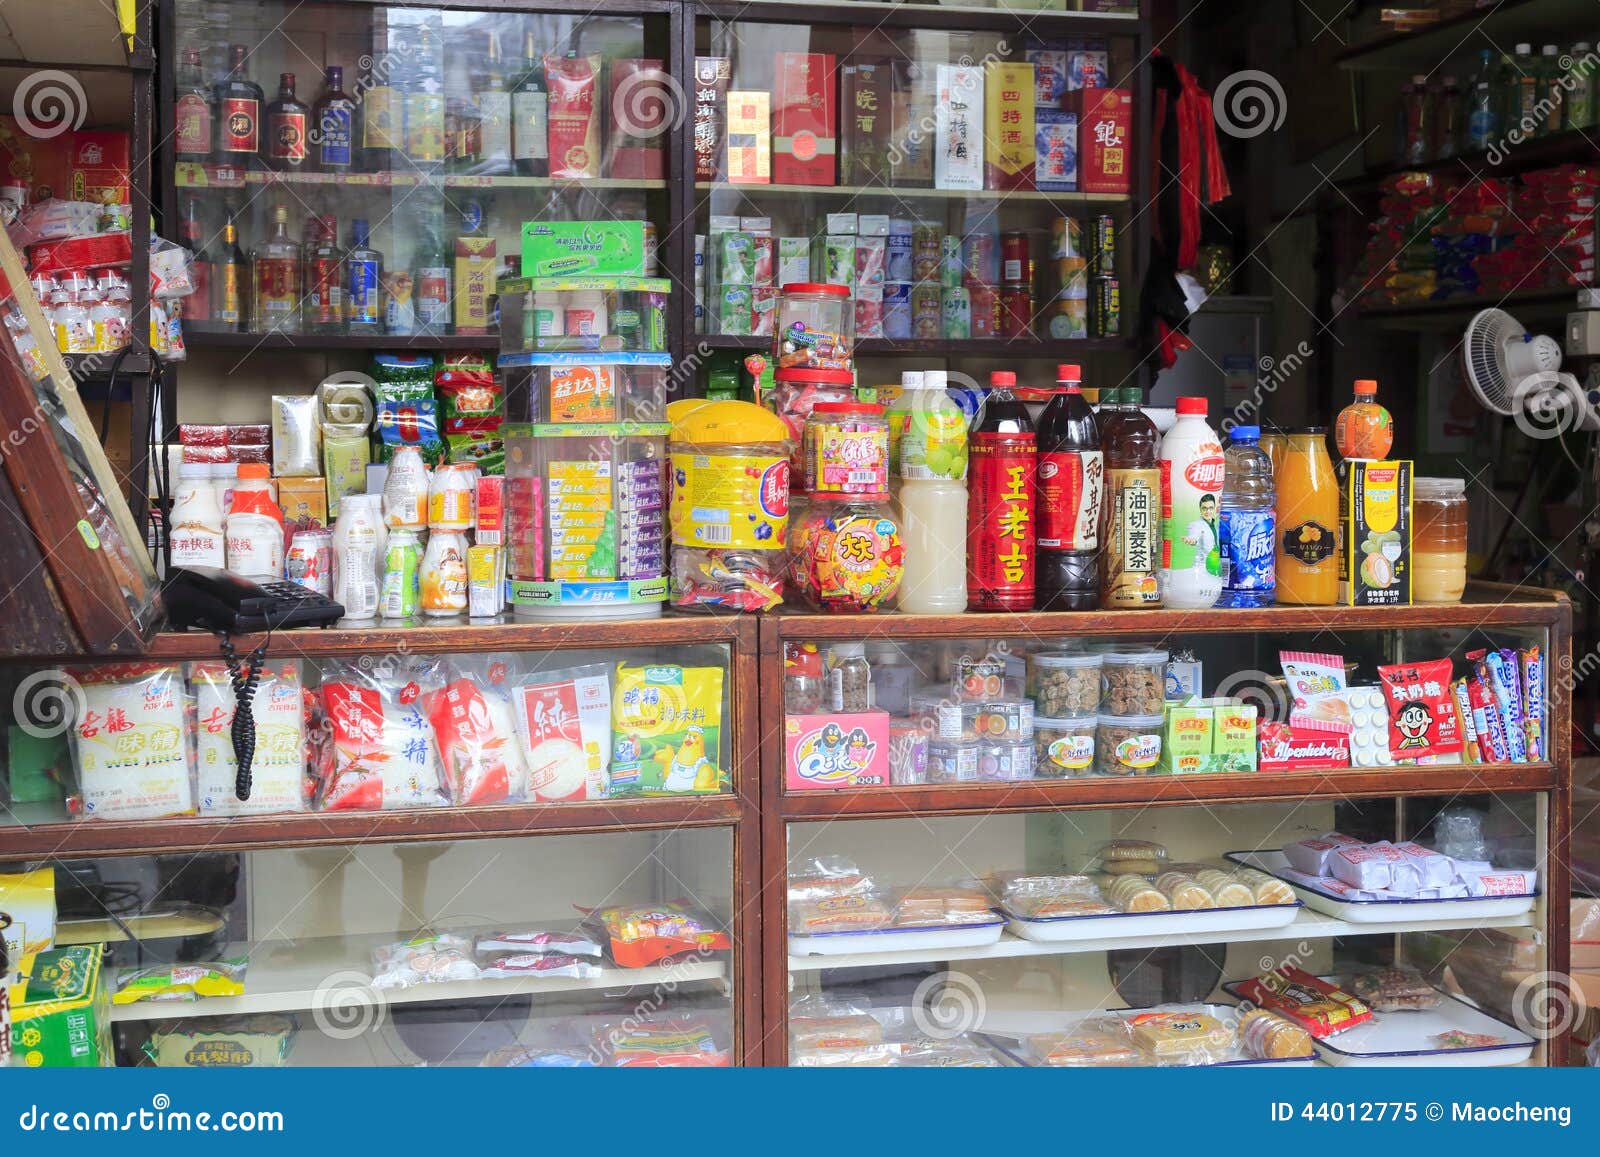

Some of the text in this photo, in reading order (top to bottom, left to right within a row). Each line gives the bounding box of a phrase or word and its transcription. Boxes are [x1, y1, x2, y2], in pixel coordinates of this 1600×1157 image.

[1002, 90, 1021, 143] 四特酒
[554, 376, 595, 399] 益达
[998, 465, 1029, 583] 王老吉
[1128, 491, 1147, 569] 油切麦茶
[170, 537, 215, 551] 营养快线
[1392, 681, 1441, 701] 牛奶糖
[115, 728, 181, 753] 味精
[402, 709, 429, 765] 味精
